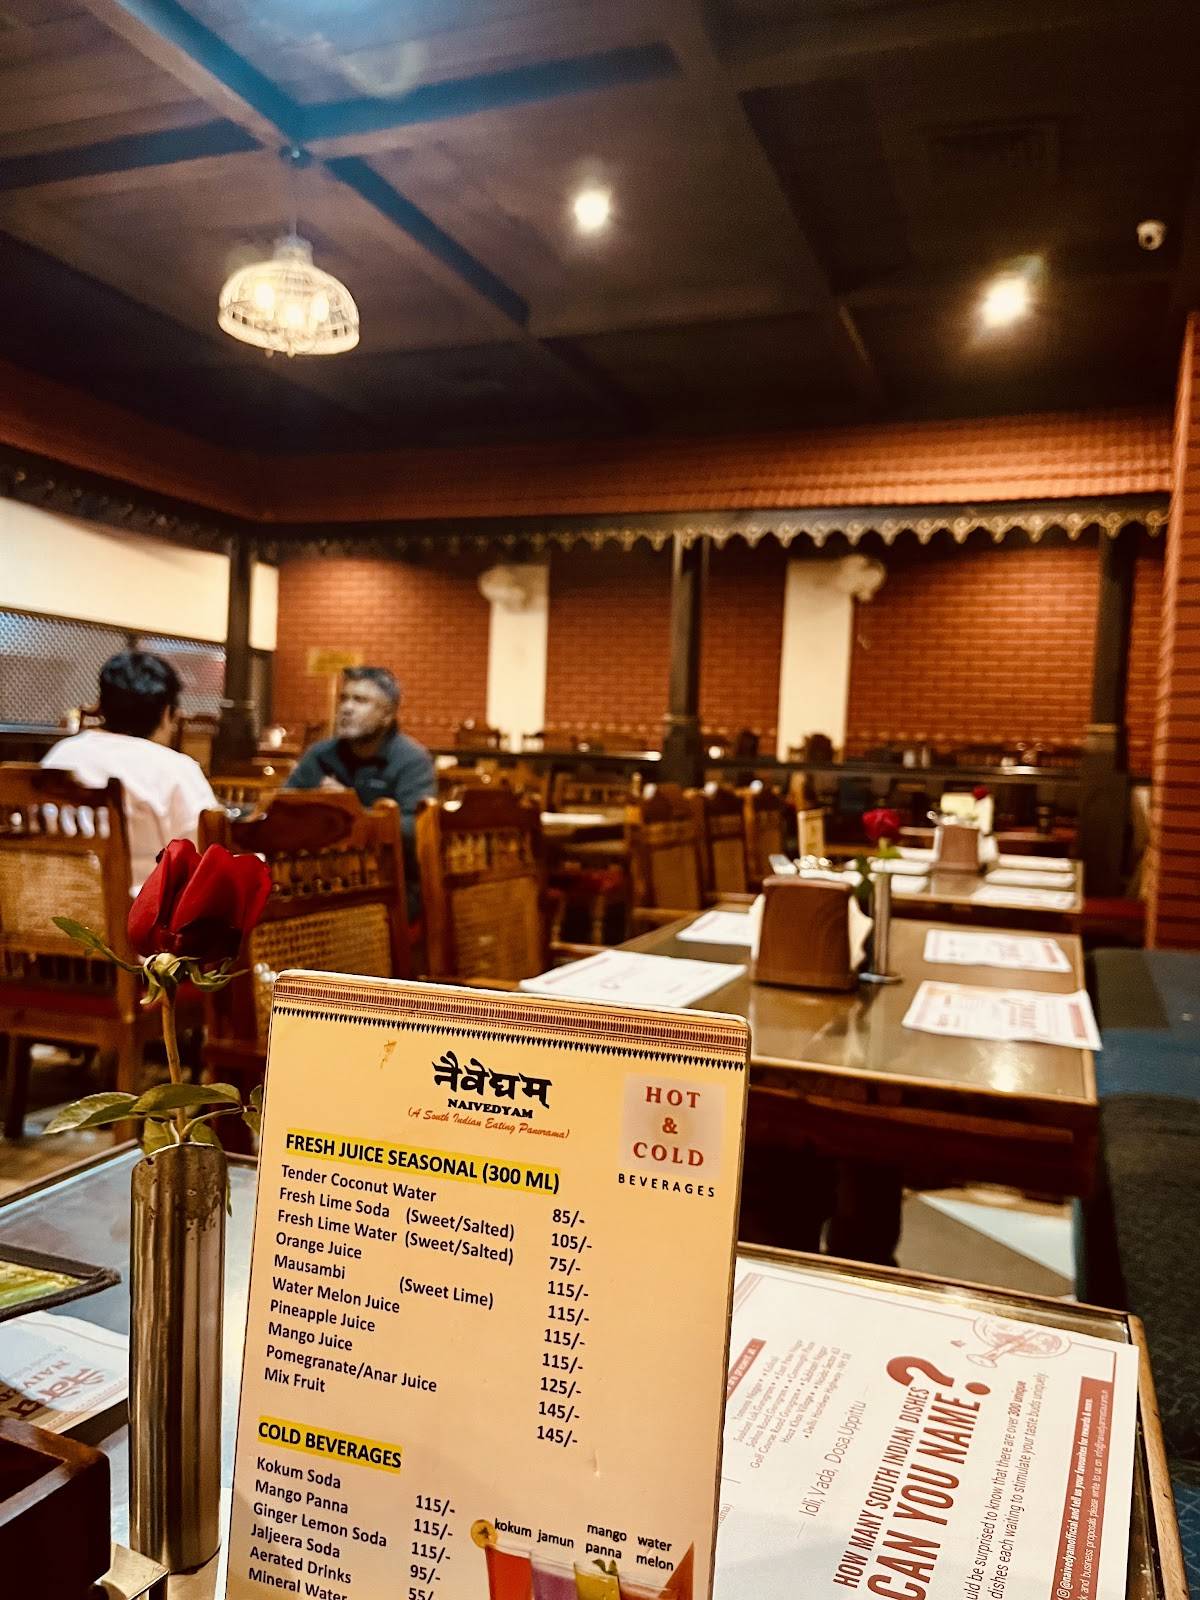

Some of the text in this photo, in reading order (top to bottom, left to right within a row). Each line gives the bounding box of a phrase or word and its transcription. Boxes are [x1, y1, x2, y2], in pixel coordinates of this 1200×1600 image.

[448, 1098, 533, 1119] NAIVEDYAM
[645, 1086, 700, 1108] HOT
[407, 1107, 571, 1139] (A South Indian Eating Panorama)
[662, 1117, 678, 1135] &
[286, 1133, 560, 1194] FRESH JUICE SEASONAL (300 ML)
[633, 1141, 704, 1167] COLD
[281, 1164, 585, 1228] Tender Coconut Water 85/-
[618, 1173, 715, 1197] BEVERAGES
[279, 1187, 593, 1253] Fresh Lime Soda (Sweet/Salted) 105/-
[277, 1209, 582, 1276] Fresh Lime Water (Sweet/Salted) 75/-
[275, 1232, 590, 1301] Orange Juice 115/-
[274, 1254, 590, 1326] Mausambi (Sweet Lime) 115/-
[272, 1276, 586, 1350] Water Melon Juice 115/-
[270, 1299, 584, 1374] Pineapple Juice 115/-
[268, 1322, 582, 1398] Mango Juice 125/-
[266, 1345, 580, 1422] Pomegranate/Anar Juice 145/-
[264, 1367, 579, 1447] Mix Fruit 145/-
[258, 1422, 402, 1469] COLD BEVERAGES
[256, 1456, 456, 1516] Kokum Soda 115/-
[832, 1386, 930, 1589] HOW MANY SOUTH INDIAN DISHES
[992, 1467, 1008, 1486] that
[1011, 1455, 1031, 1494] stimulate
[255, 1479, 454, 1540] Mango Panna 115/-
[892, 1463, 960, 1526] YOU
[984, 1486, 1003, 1511] know
[1010, 1494, 1023, 1504] to
[1069, 1506, 1080, 1520] and
[253, 1501, 451, 1564] Ginger Lemon Soda 115/-
[494, 1518, 575, 1549] kokum jamun
[984, 1511, 998, 1521] to
[1003, 1504, 1025, 1537] waiting
[250, 1523, 441, 1584] Jaljeera Soda 95/-
[585, 1541, 674, 1571] panna melon
[587, 1523, 673, 1552] mango water
[975, 1520, 996, 1567] surprised
[998, 1539, 1014, 1563] each
[1060, 1519, 1079, 1590] @naivedyamofficial
[249, 1546, 304, 1571] Aerated
[307, 1560, 352, 1584] Drinks
[867, 1529, 941, 1600] CAN
[966, 1567, 984, 1582] be
[986, 1564, 1009, 1600] dishes
[1080, 1548, 1094, 1578] business
[248, 1567, 348, 1600] Mineral Water
[1080, 1578, 1090, 1593] and
